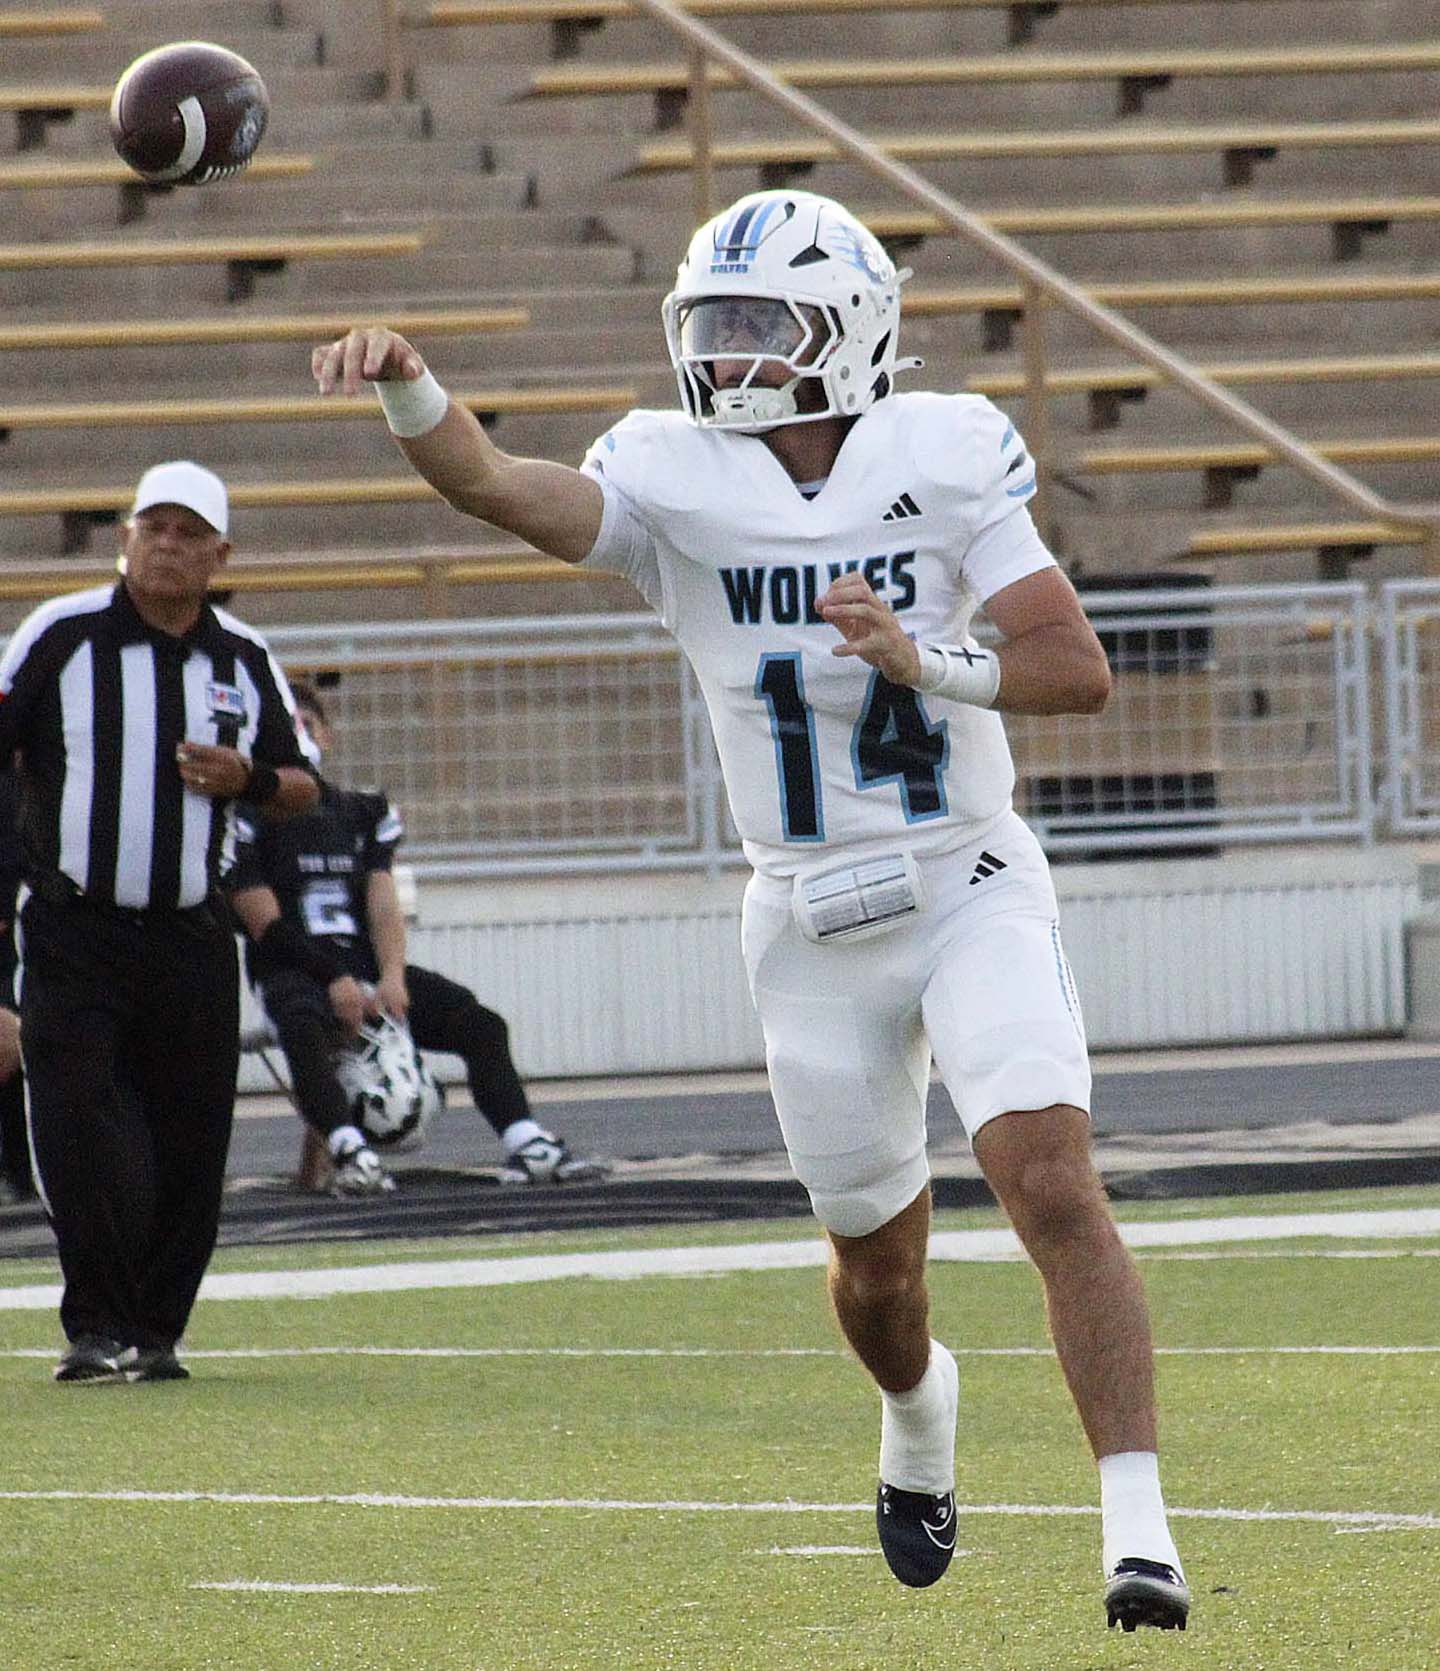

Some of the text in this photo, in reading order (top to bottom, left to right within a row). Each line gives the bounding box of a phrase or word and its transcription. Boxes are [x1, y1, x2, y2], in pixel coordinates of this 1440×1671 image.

[710, 264, 749, 273] WOLVES
[718, 551, 916, 626] WOLES
[754, 648, 950, 842] 14
